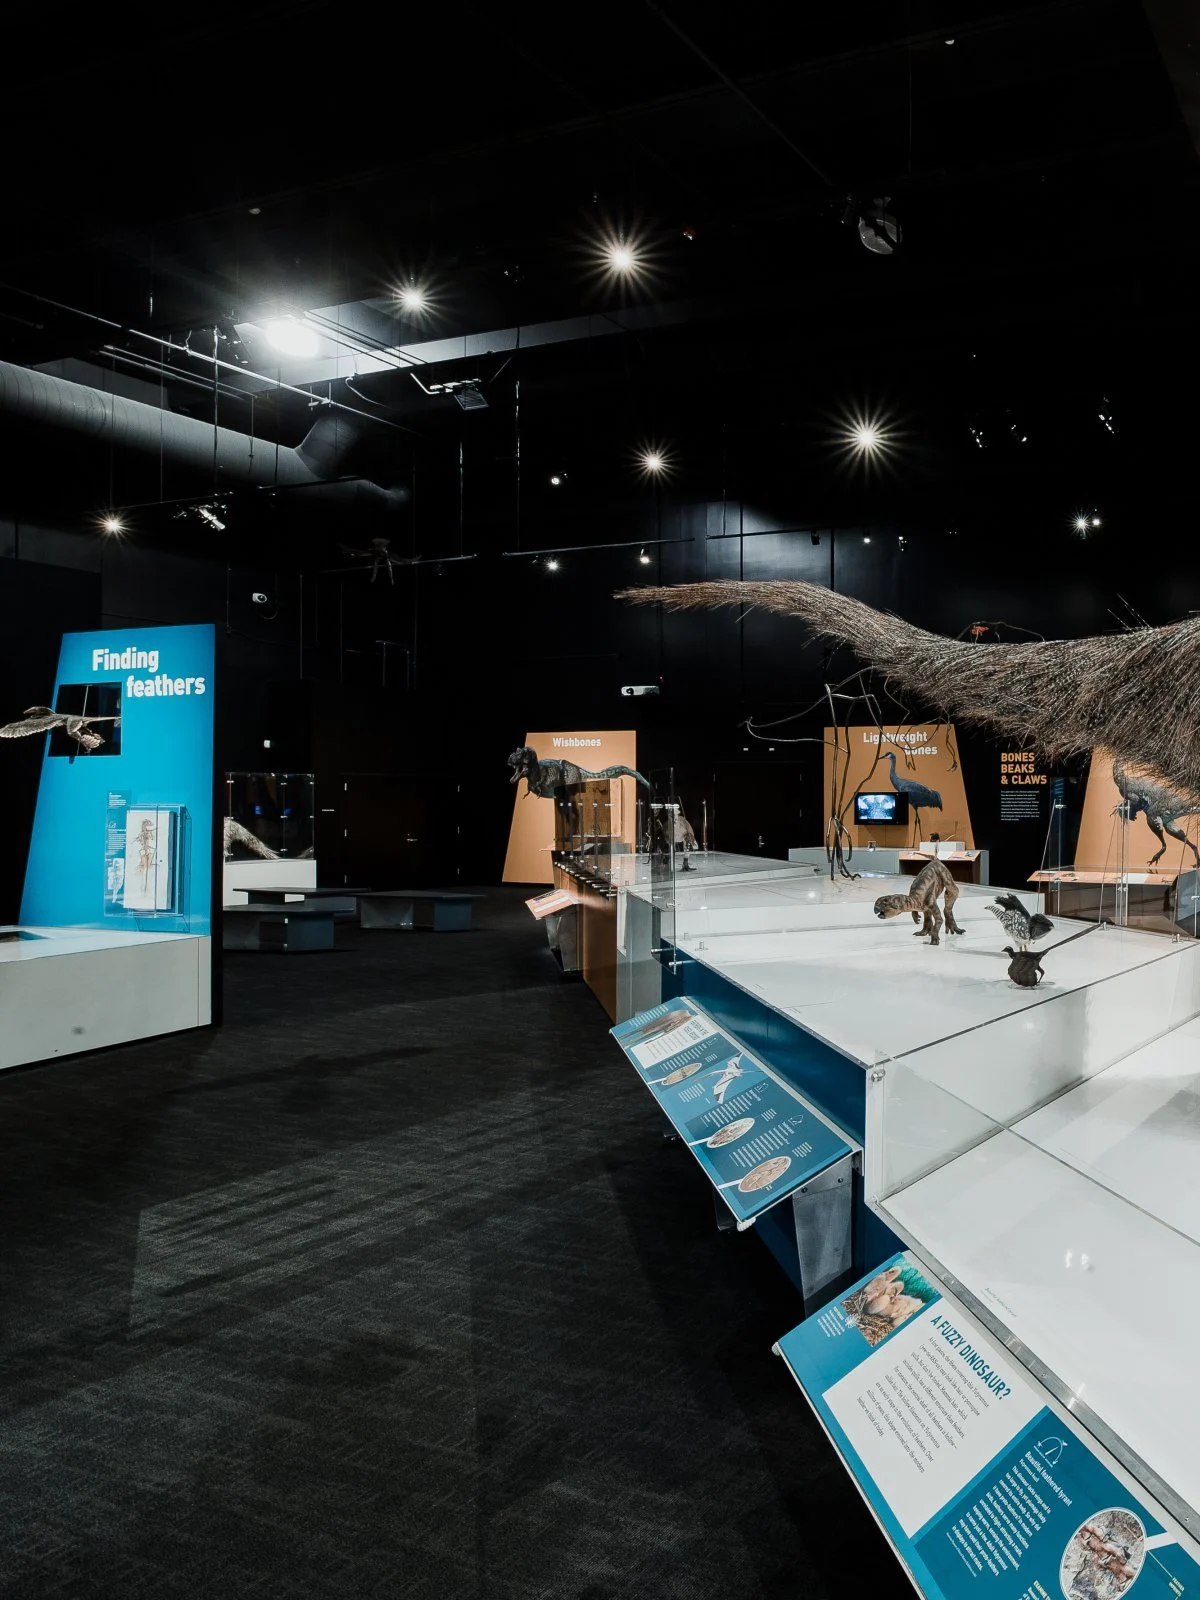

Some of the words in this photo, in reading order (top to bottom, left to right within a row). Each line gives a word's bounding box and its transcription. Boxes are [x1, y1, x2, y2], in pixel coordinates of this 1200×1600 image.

[92, 647, 159, 673] Finding
[126, 674, 206, 697] feathers
[552, 737, 601, 747] Wishbones
[1001, 752, 1035, 762] BONES
[1001, 763, 1035, 773] BEAKS
[1001, 775, 1008, 785] &
[1011, 775, 1047, 785] CLAWS
[931, 1315, 943, 1326] A
[936, 1320, 966, 1350] FUZZY
[958, 1344, 1012, 1401] DINOSAUR?
[1024, 1450, 1044, 1473] Beautiful
[1040, 1468, 1062, 1493] feathered
[1056, 1488, 1073, 1508] tyrant
